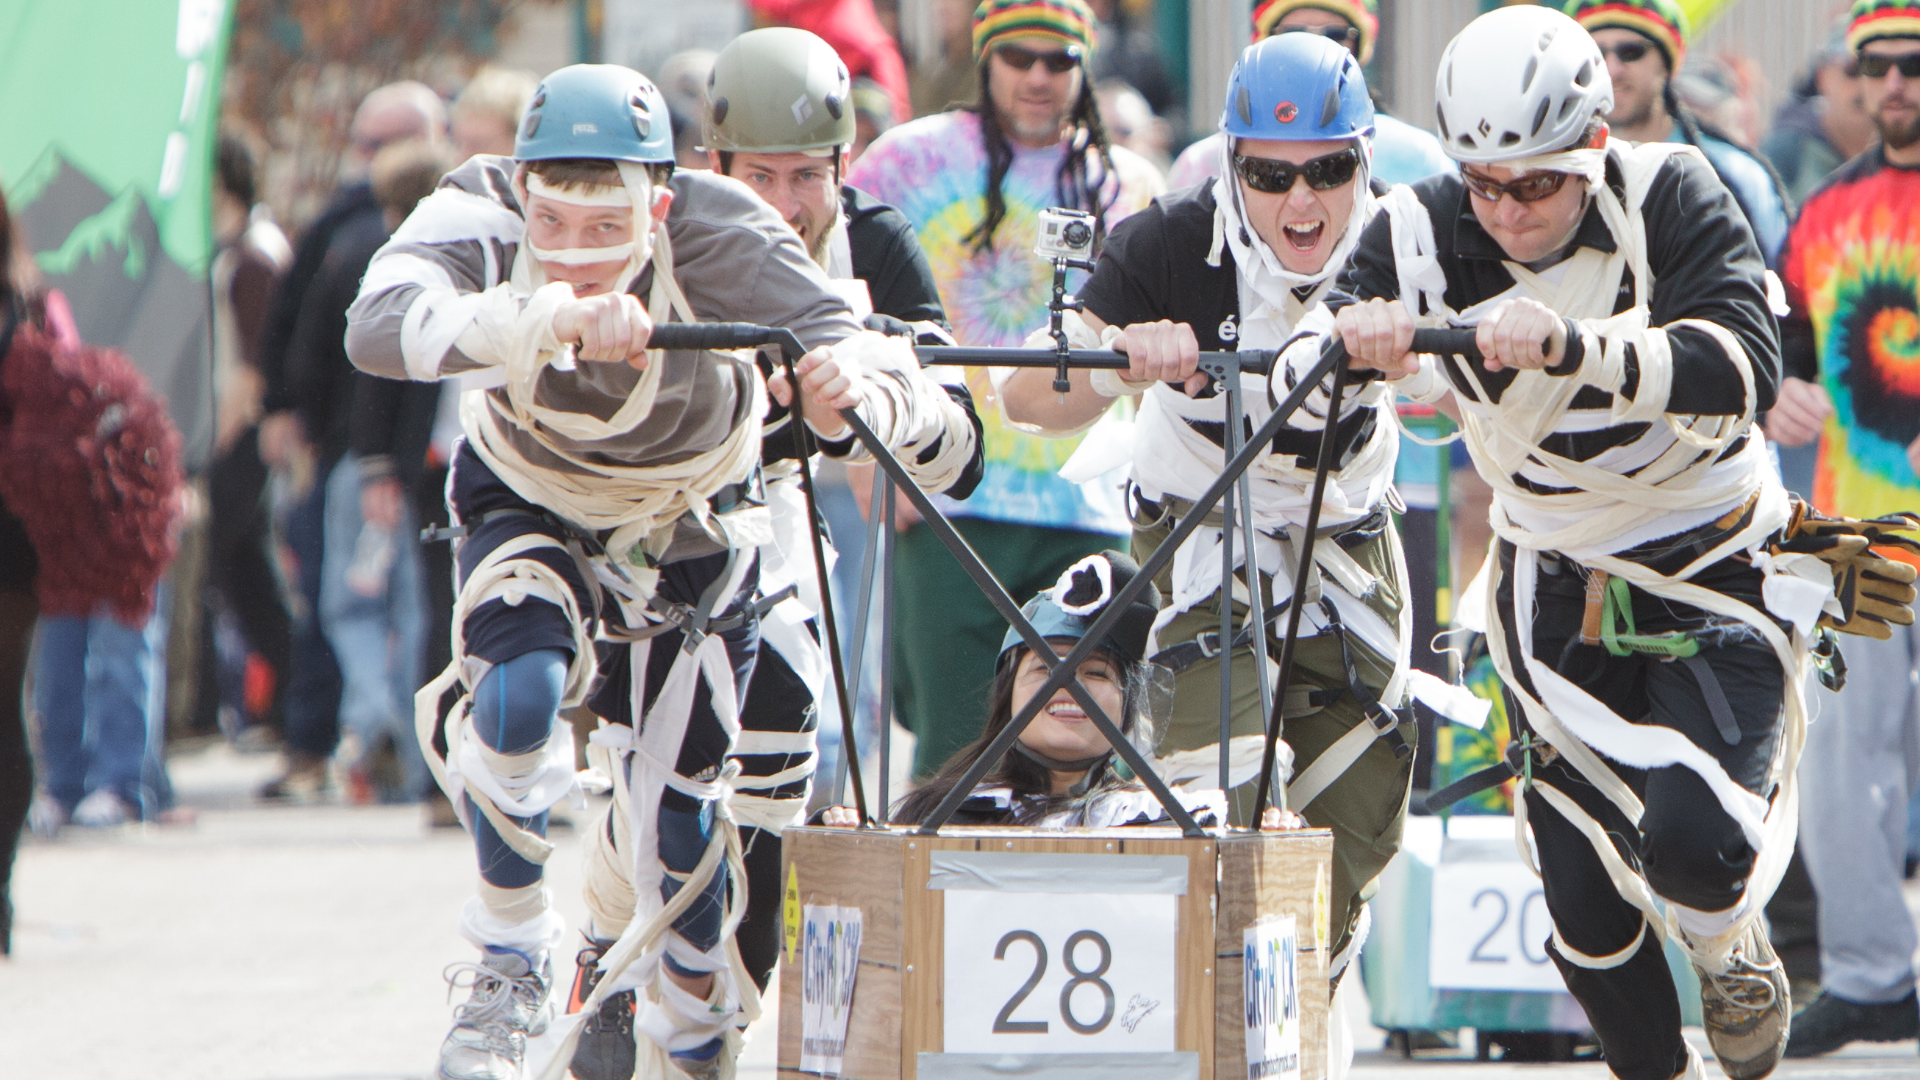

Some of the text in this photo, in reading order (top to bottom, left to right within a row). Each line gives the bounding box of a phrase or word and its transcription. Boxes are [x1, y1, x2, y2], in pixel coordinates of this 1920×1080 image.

[1218, 313, 1241, 342] é
[1468, 888, 1554, 965] 20
[992, 929, 1115, 1036] 28
